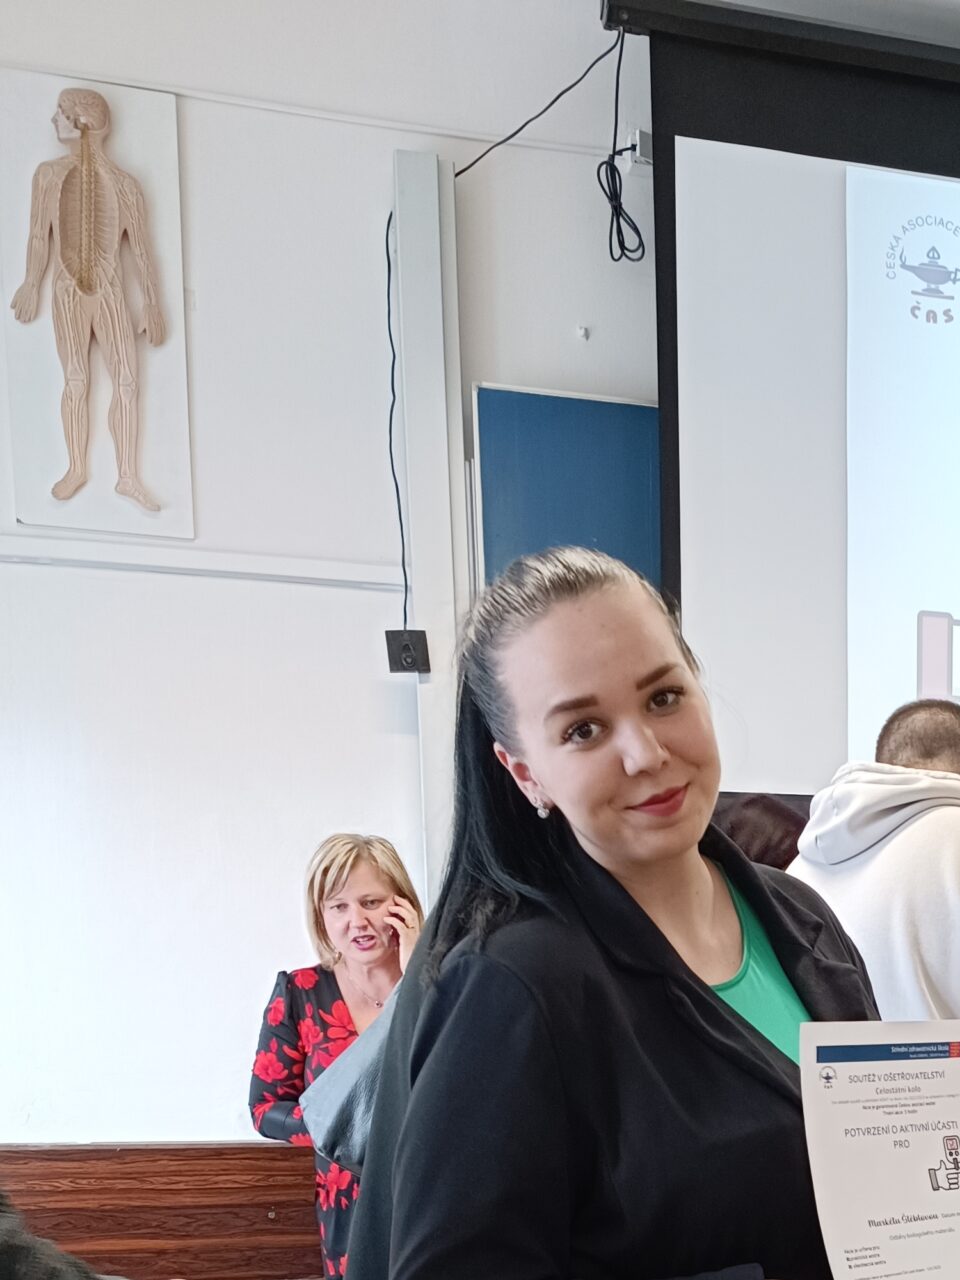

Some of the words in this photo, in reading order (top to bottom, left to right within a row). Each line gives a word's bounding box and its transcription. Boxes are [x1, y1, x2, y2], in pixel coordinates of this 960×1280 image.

[848, 1073, 876, 1084] SOUTĚŽ
[883, 1070, 945, 1083] OŠETŘOVATELSTVÍ
[844, 1125, 891, 1138] POTVRZENÍ
[891, 1125, 899, 1134] O
[900, 1122, 930, 1134] AKTIVNÍ
[931, 1120, 959, 1131] ÚČASTI
[893, 1139, 910, 1149] PRO
